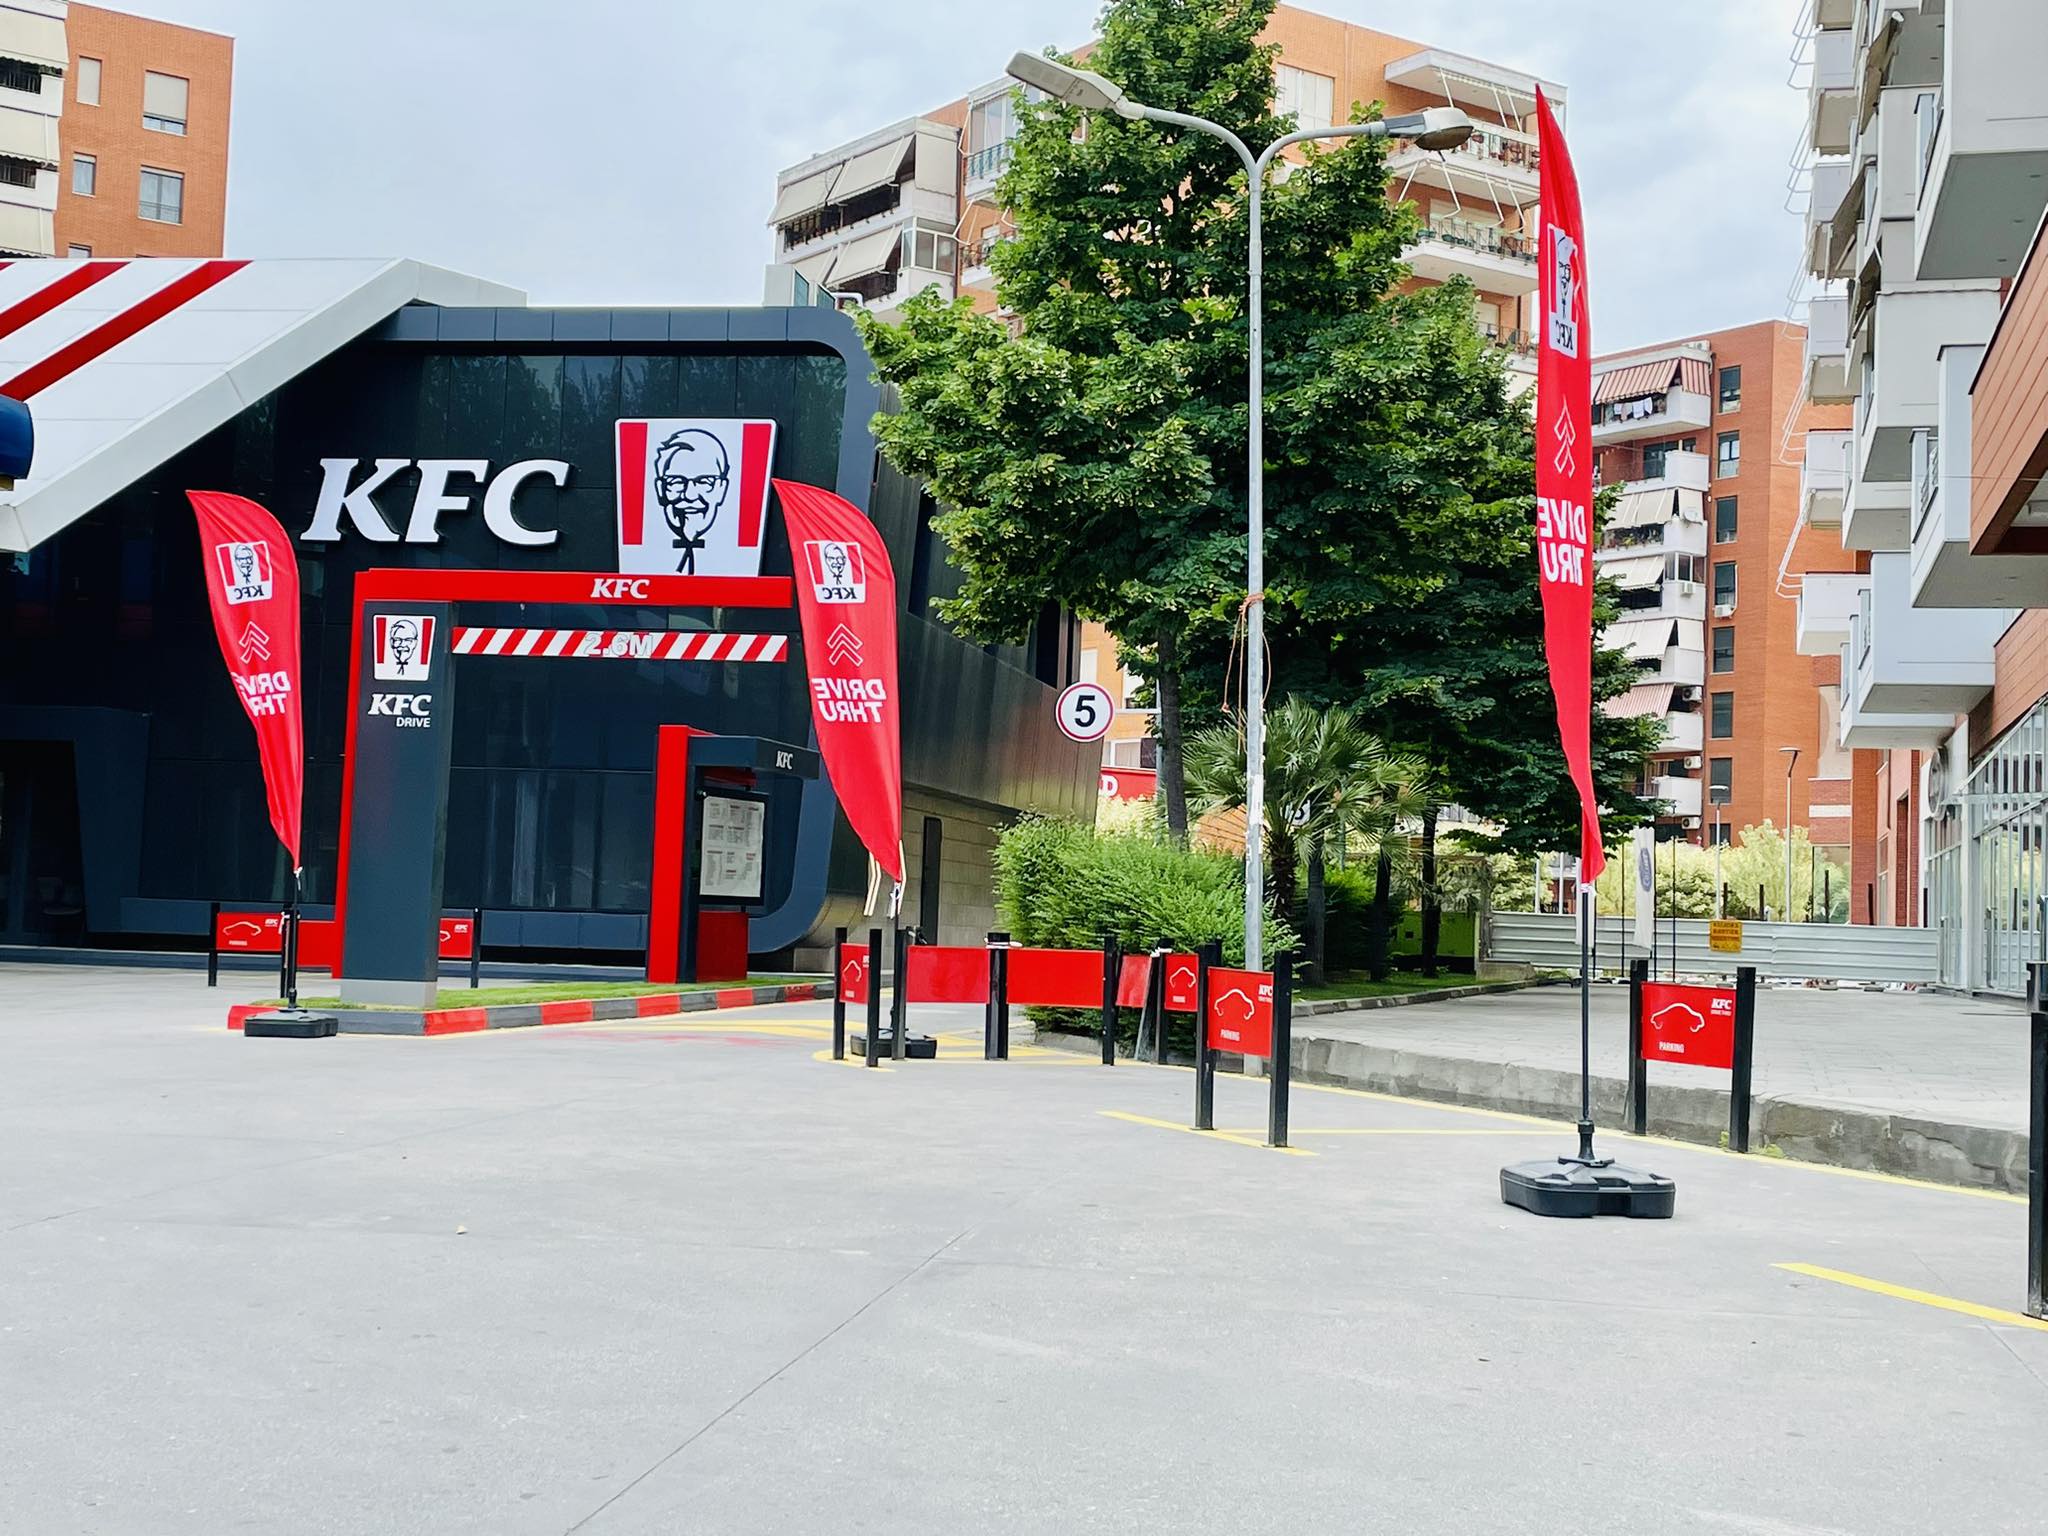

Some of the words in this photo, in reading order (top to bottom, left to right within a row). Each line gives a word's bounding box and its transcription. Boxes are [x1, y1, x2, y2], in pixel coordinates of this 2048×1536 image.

[300, 458, 569, 545] KFC
[590, 578, 650, 599] KFC
[583, 632, 654, 657] 2.6M
[368, 693, 433, 716] KFC
[1074, 695, 1096, 728] 5
[396, 717, 431, 728] DRIVE
[775, 750, 794, 770] KFC
[1711, 998, 1732, 1009] KFC
